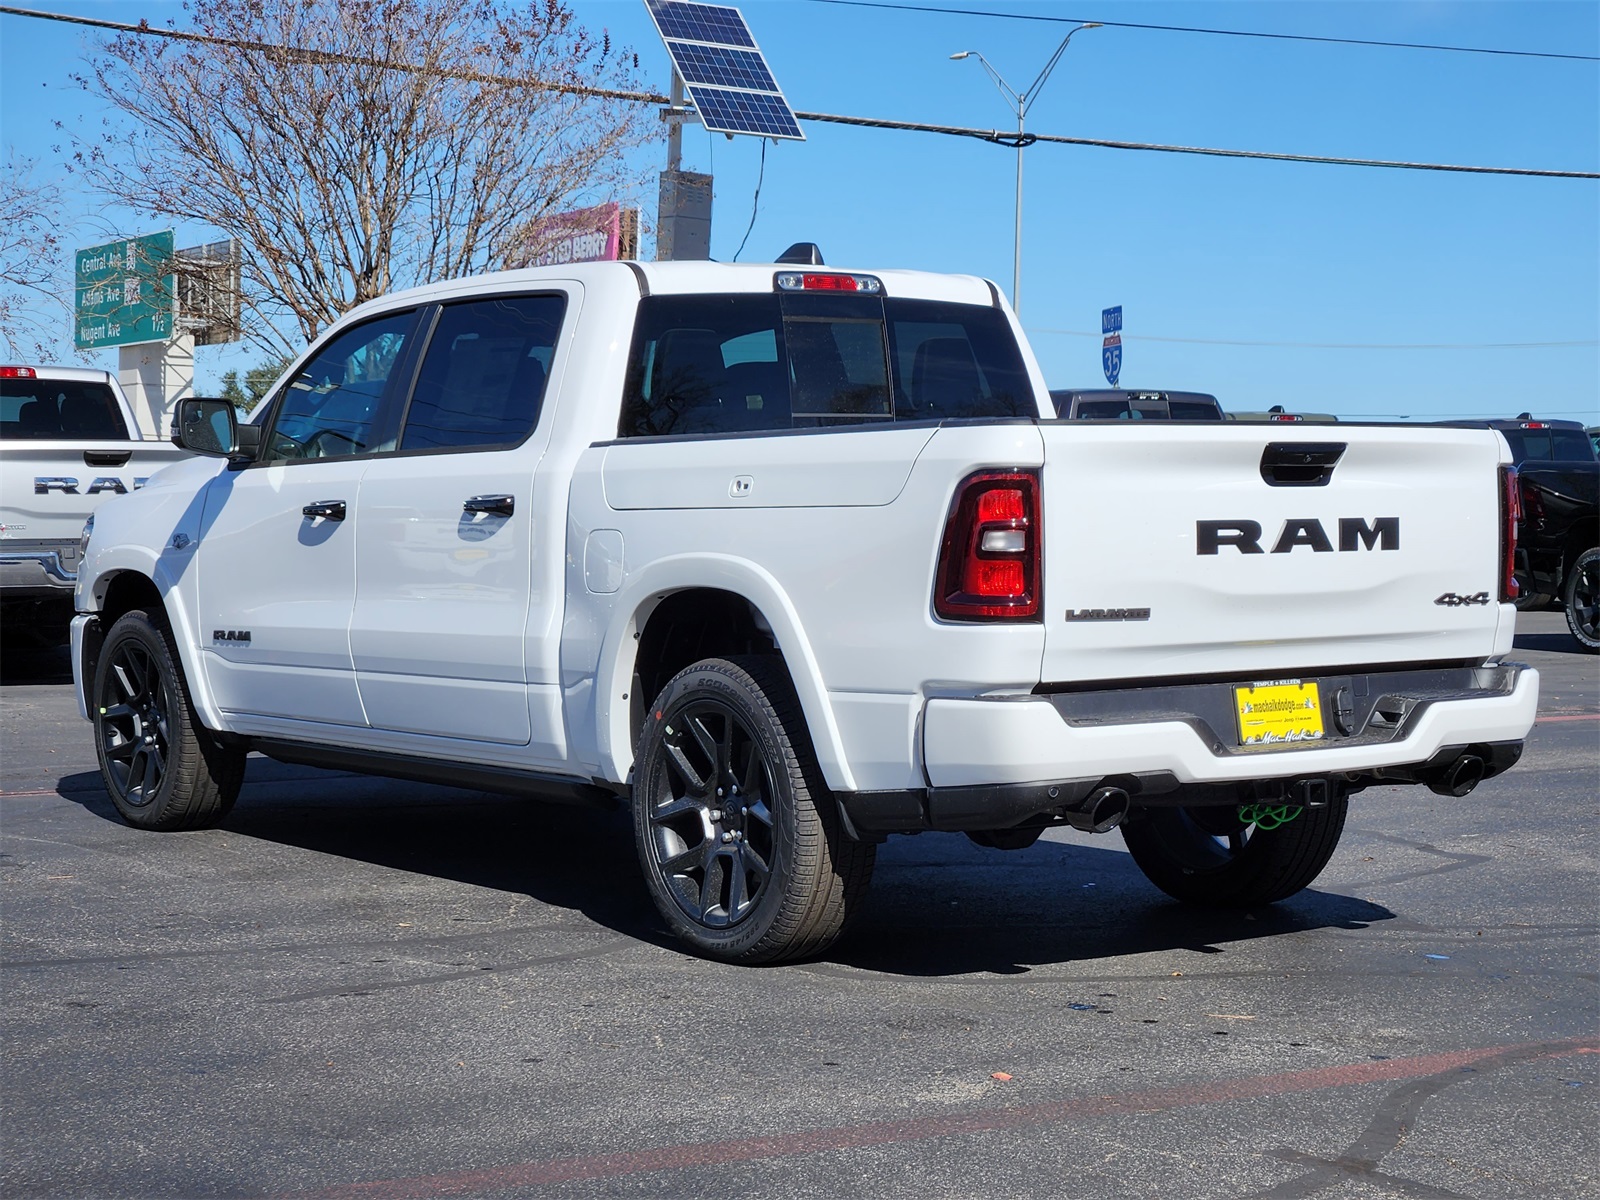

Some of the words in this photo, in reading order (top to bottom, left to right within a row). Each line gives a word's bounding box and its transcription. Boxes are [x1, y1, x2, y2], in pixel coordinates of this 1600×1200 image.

[573, 232, 608, 259] BERRY
[81, 254, 106, 273] Central
[108, 252, 122, 268] Ave
[82, 289, 104, 307] Adams
[107, 287, 120, 302] Ave
[1103, 312, 1121, 329] NORTH
[81, 324, 105, 344] Nugent
[107, 323, 120, 337] Ave
[1105, 350, 1120, 377] 35
[1196, 517, 1400, 555] RAM
[1433, 591, 1491, 607] 4x4
[1065, 608, 1151, 622] LARAMIE
[213, 630, 252, 642] RAM
